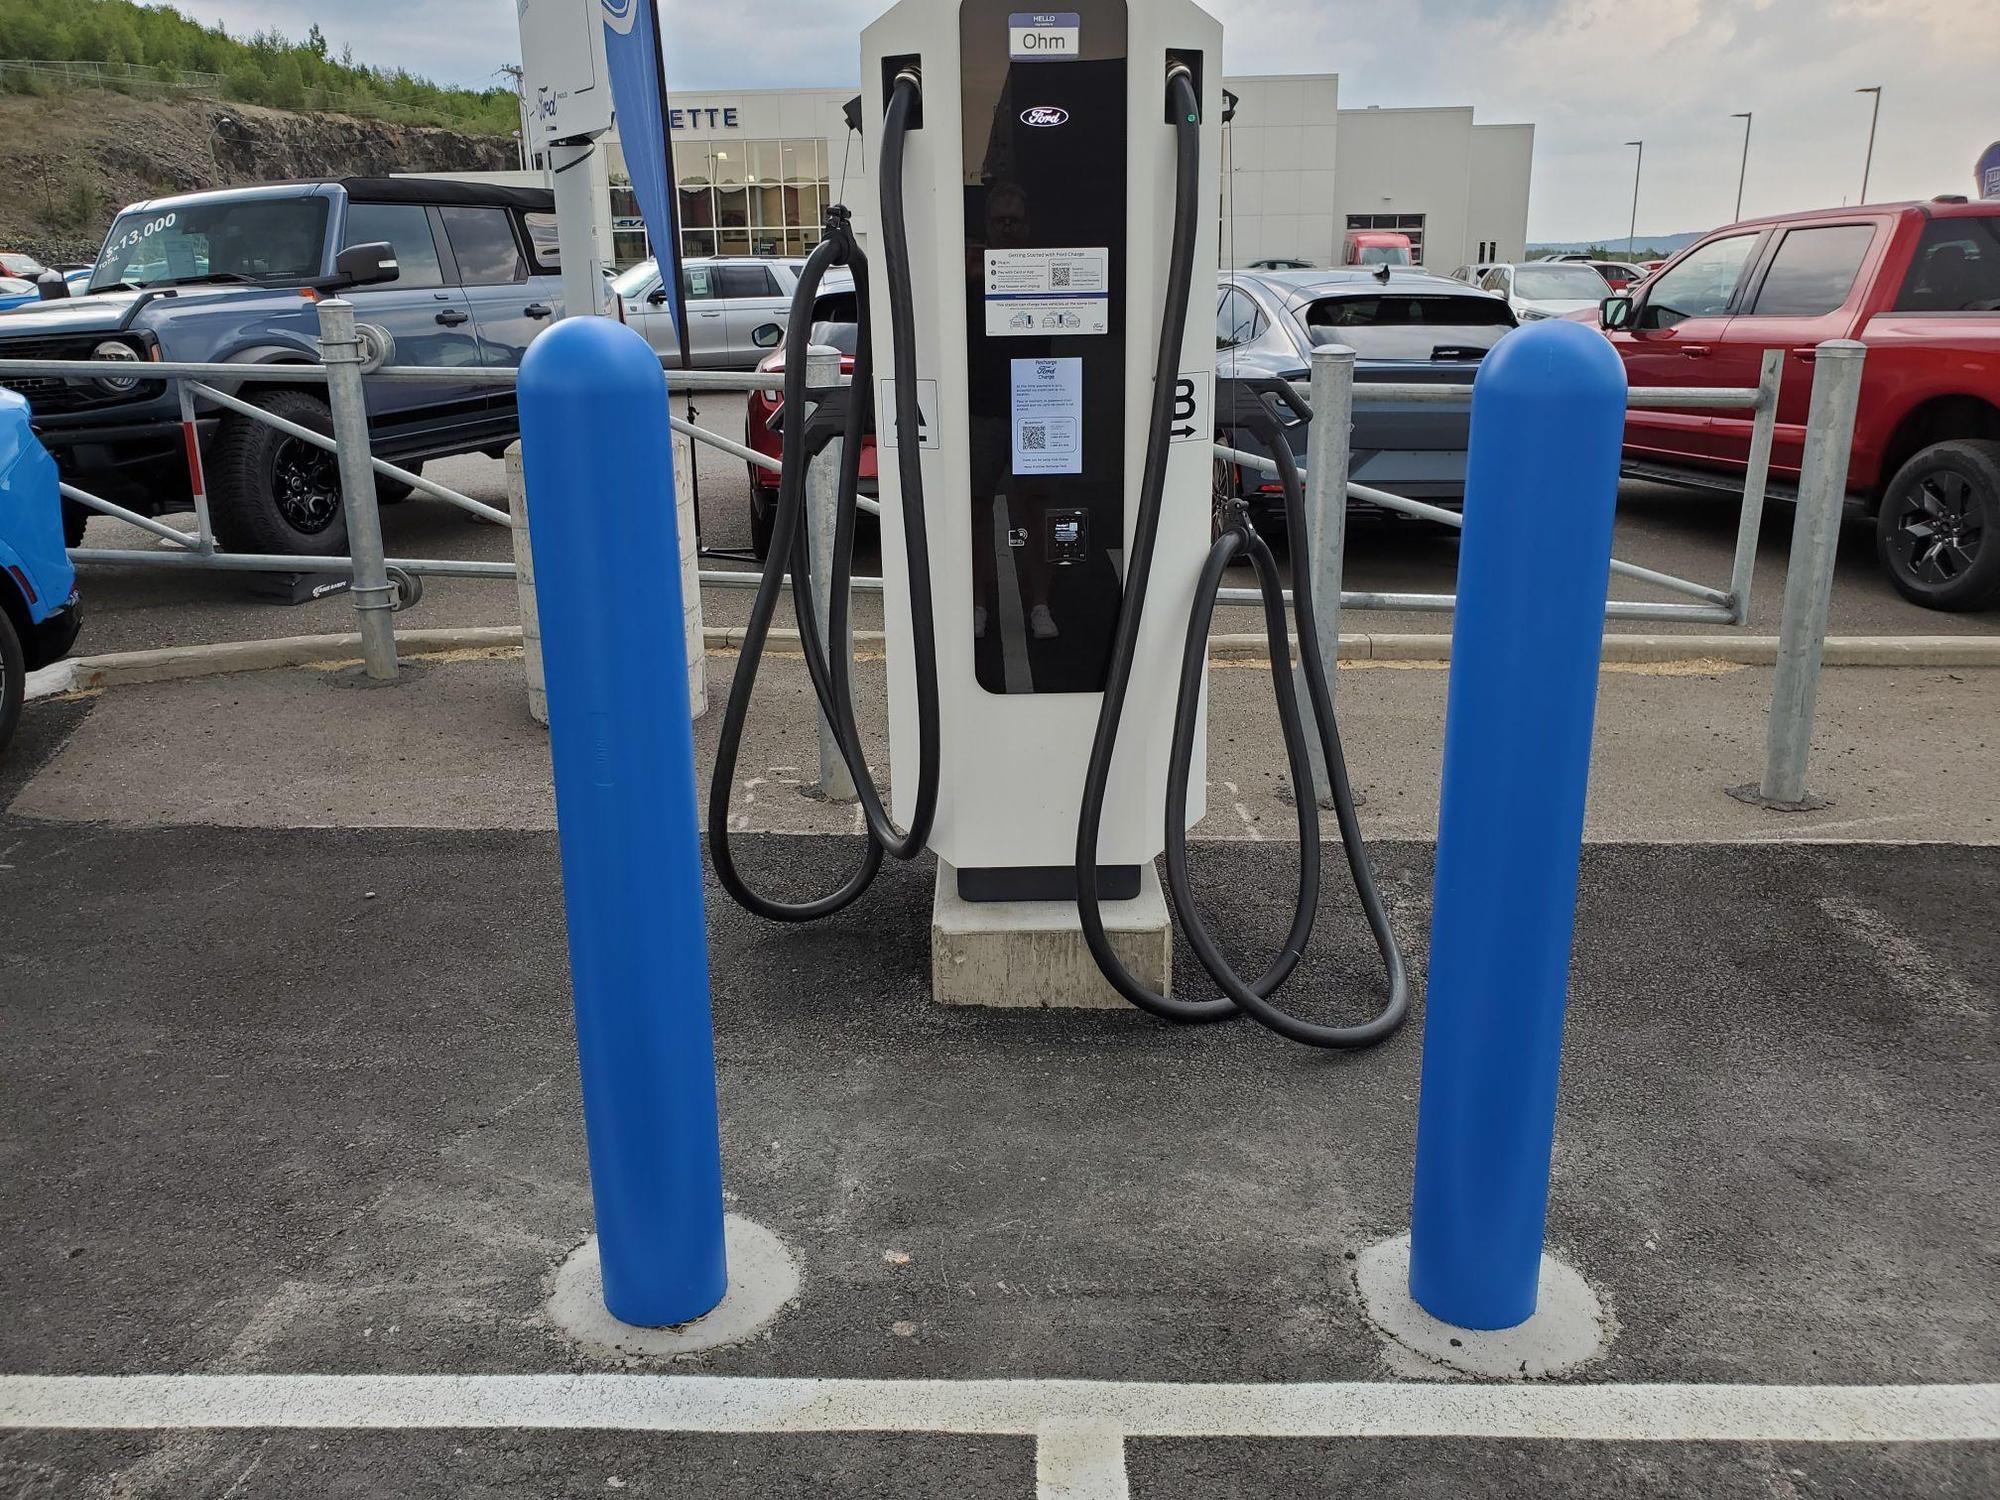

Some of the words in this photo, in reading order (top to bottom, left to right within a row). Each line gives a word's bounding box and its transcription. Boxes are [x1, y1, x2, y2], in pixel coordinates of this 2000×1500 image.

[1023, 33, 1065, 49] Ohm
[1028, 109, 1061, 124] Ford
[106, 213, 176, 258] $-13,000
[99, 255, 120, 271] TOTAL
[1037, 365, 1057, 375] Ford
[1172, 379, 1196, 421] B
